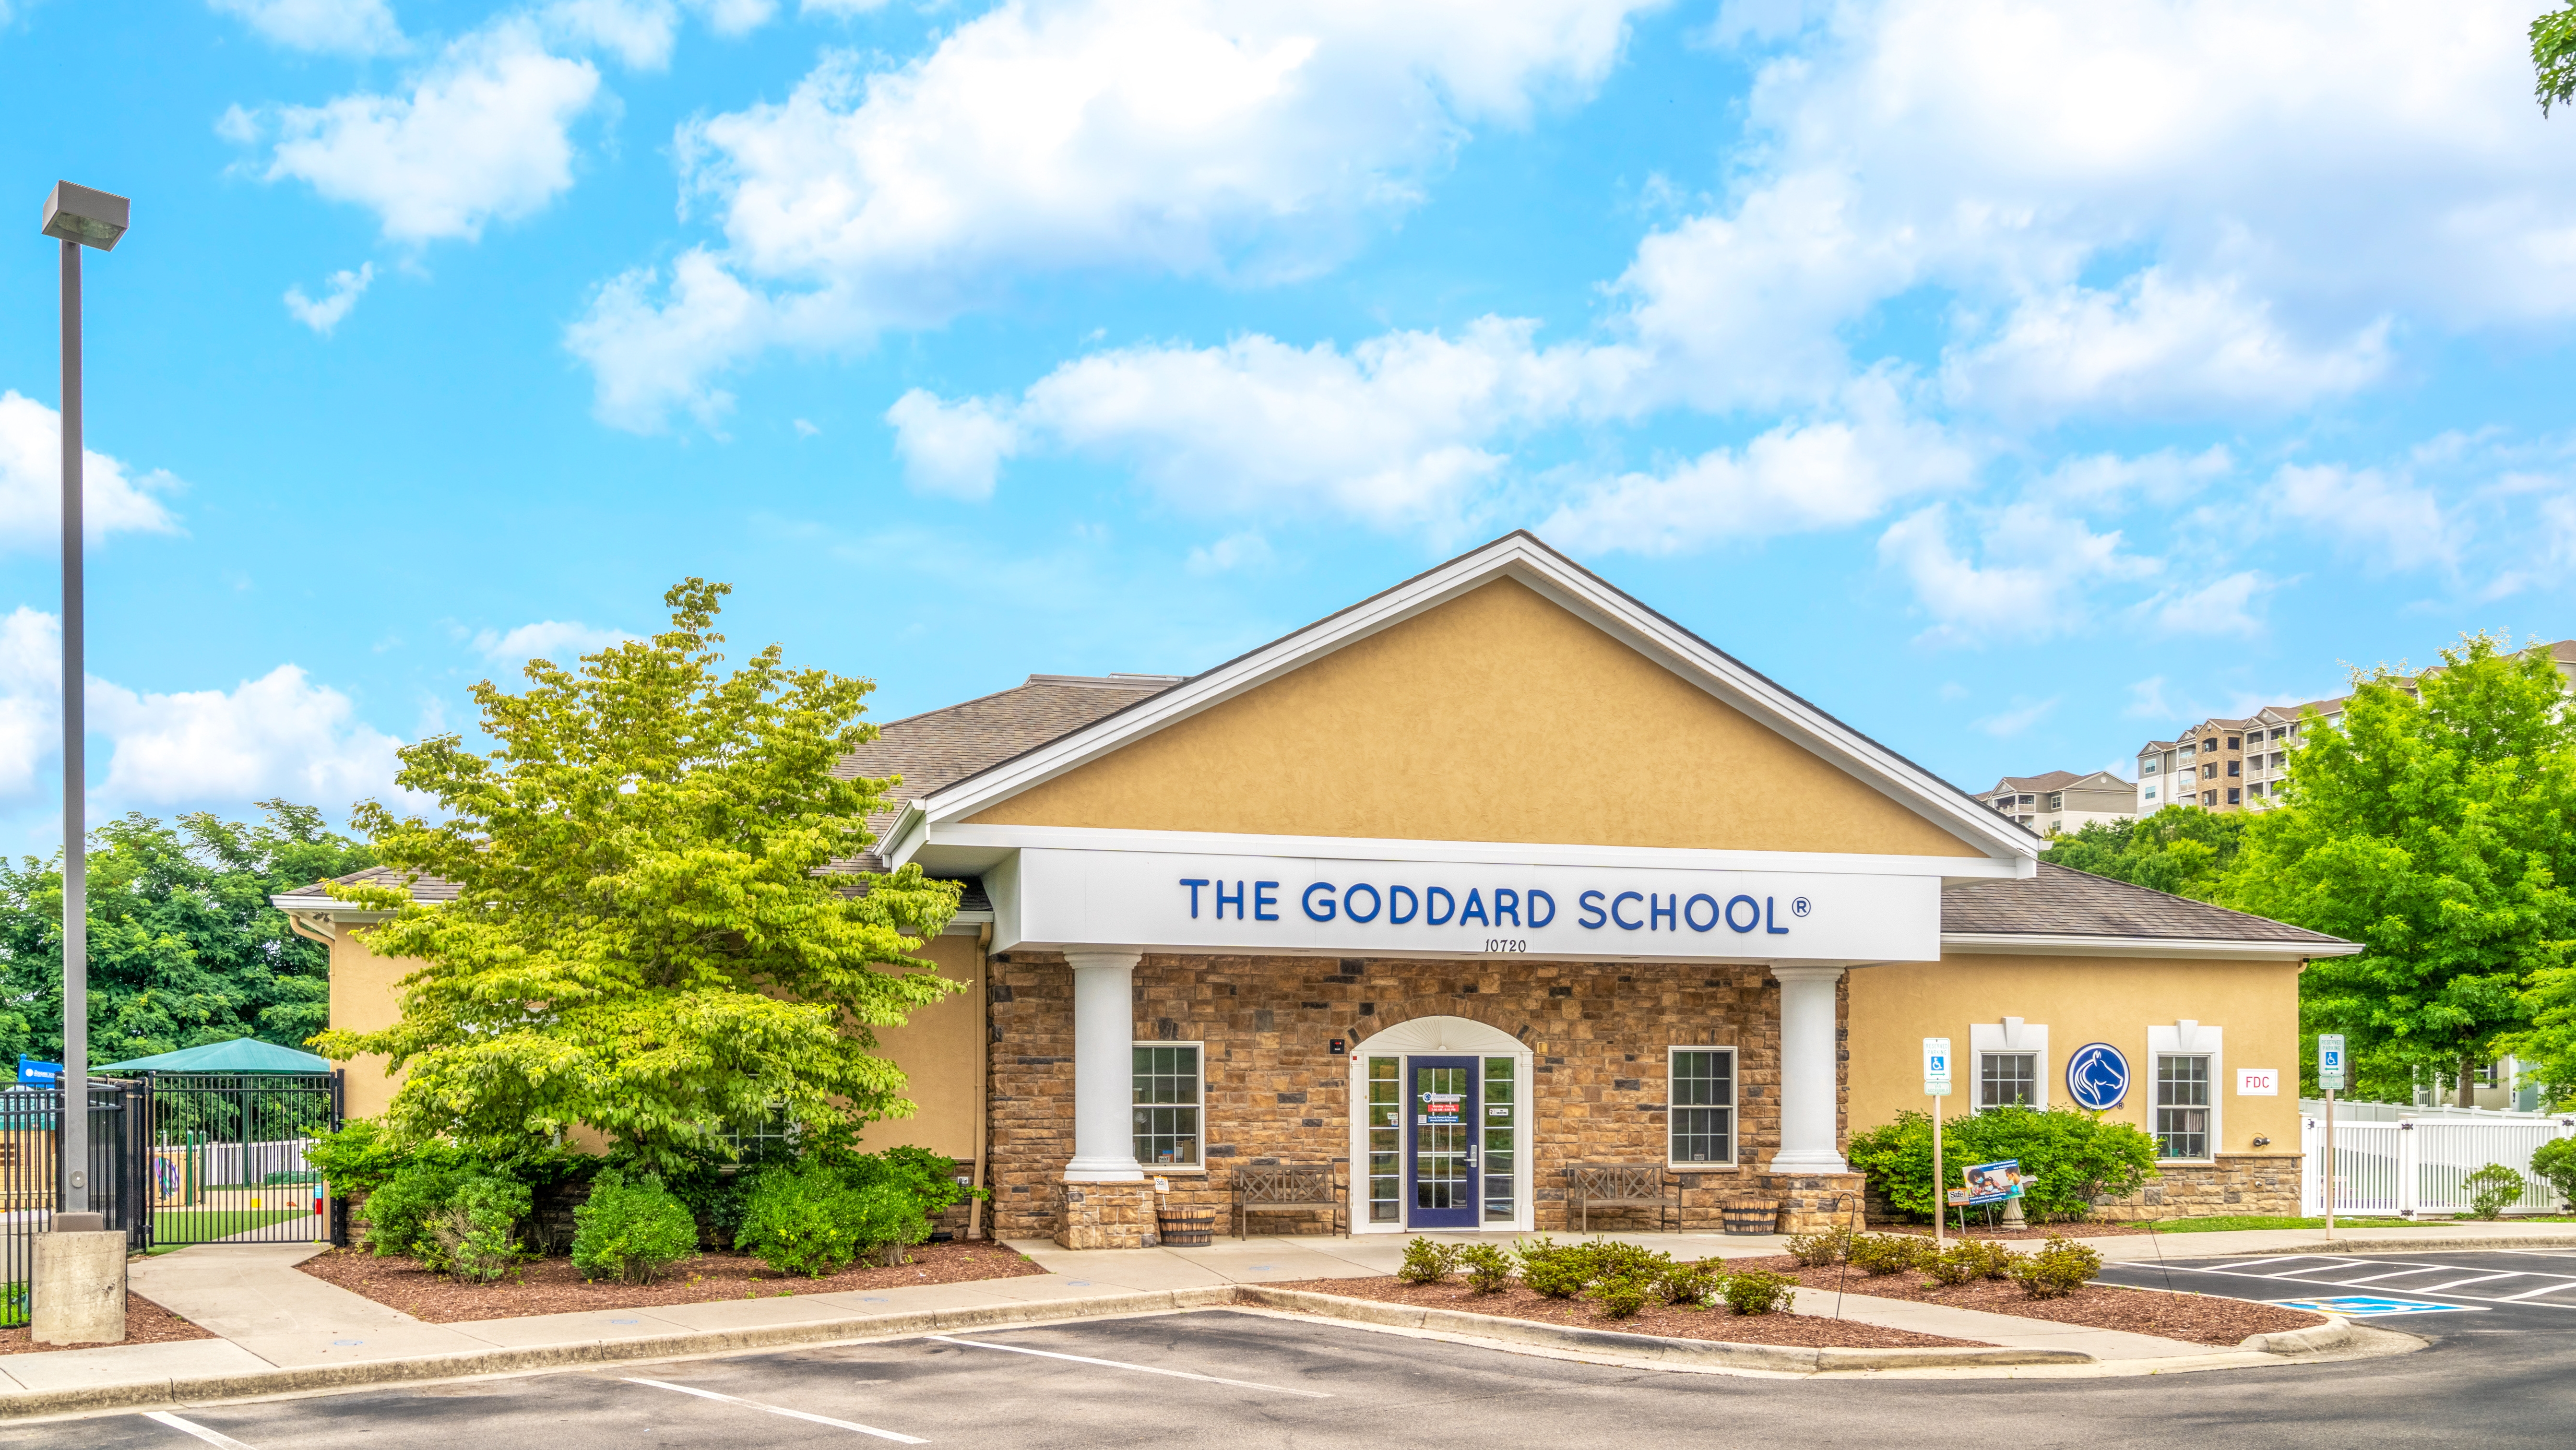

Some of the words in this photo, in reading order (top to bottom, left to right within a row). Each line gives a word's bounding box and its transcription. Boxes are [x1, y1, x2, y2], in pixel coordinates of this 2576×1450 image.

[1180, 879, 1279, 920] THE
[1302, 882, 1555, 927] GODDARD
[1485, 939, 1526, 952] 10720
[2246, 1076, 2269, 1088] FDC
